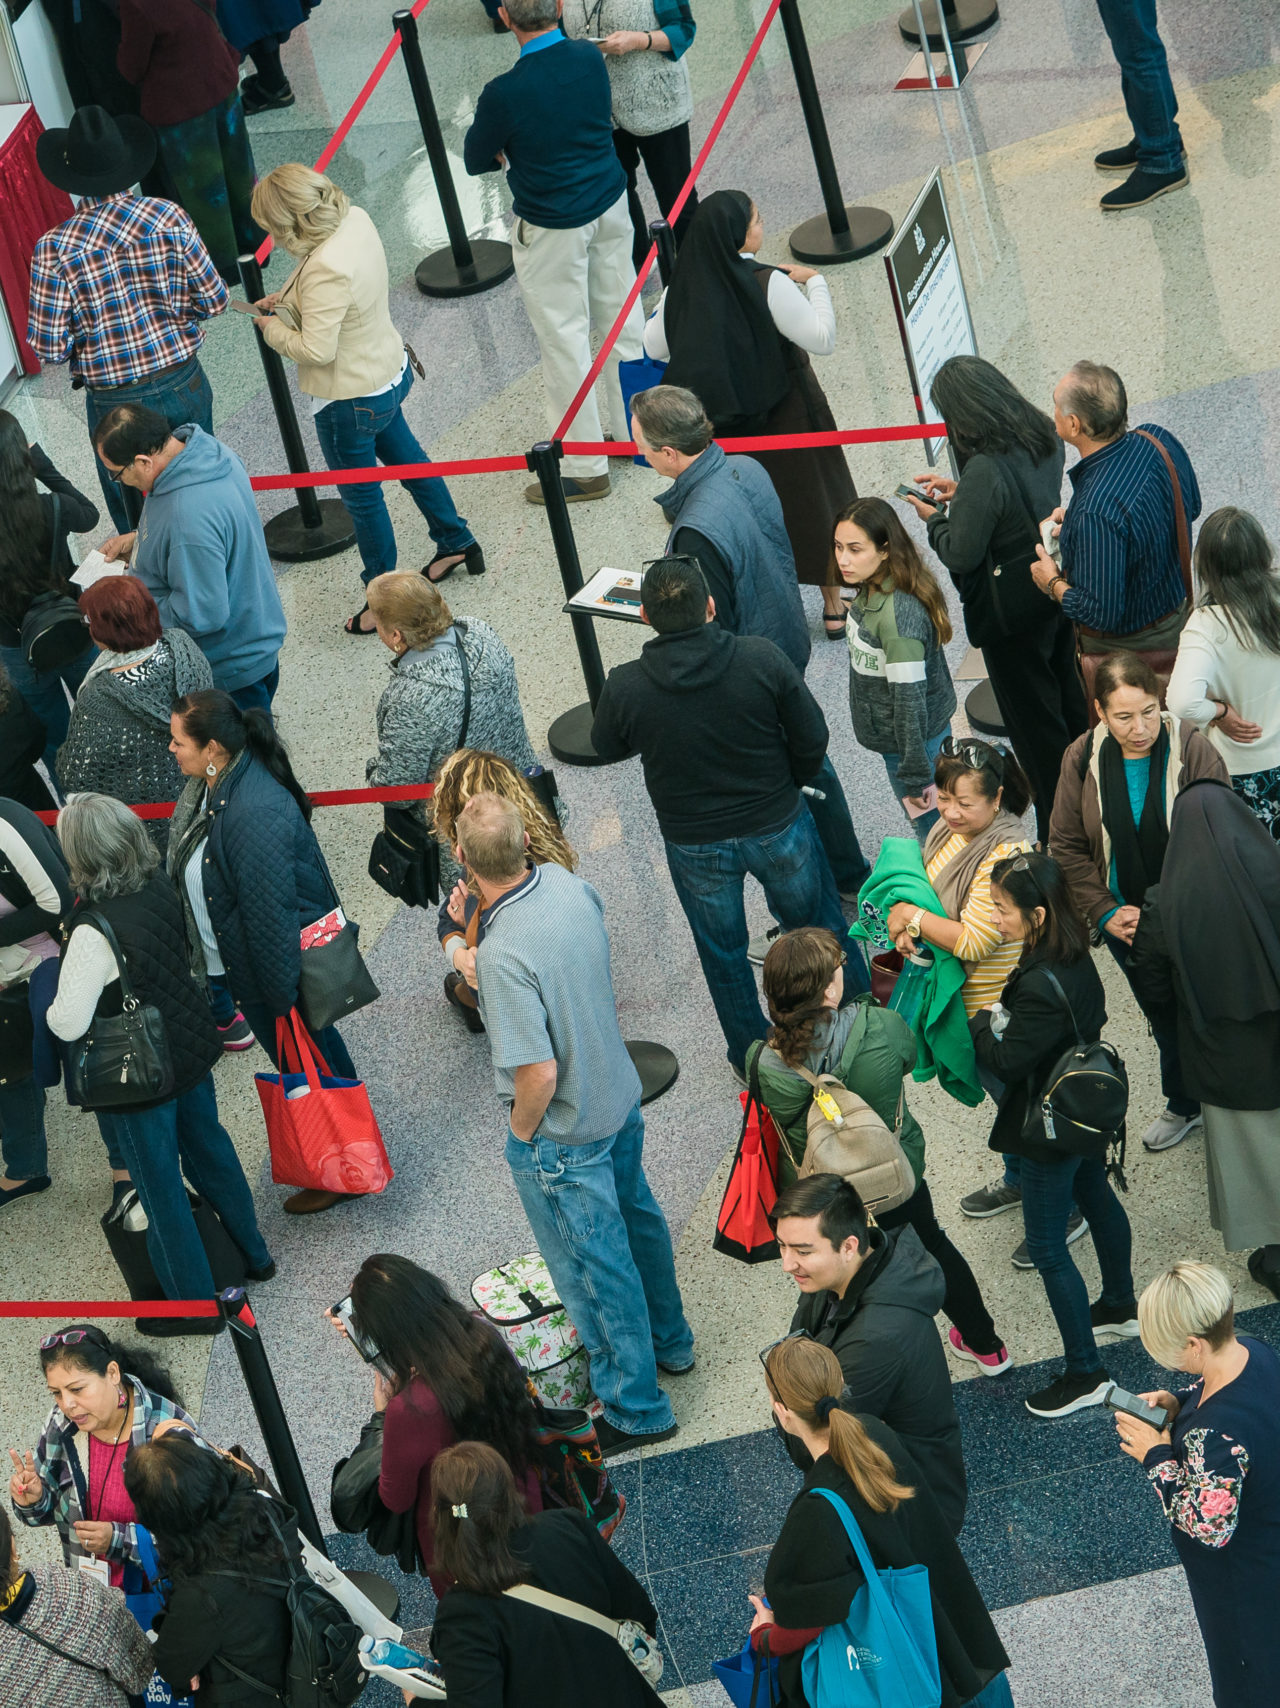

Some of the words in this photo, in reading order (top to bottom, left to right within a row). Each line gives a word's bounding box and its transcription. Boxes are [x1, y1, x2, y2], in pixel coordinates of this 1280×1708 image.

[907, 257, 933, 305] Registration
[931, 235, 946, 262] Hours
[148, 1682, 163, 1693] Be
[146, 1691, 171, 1704] Holy
